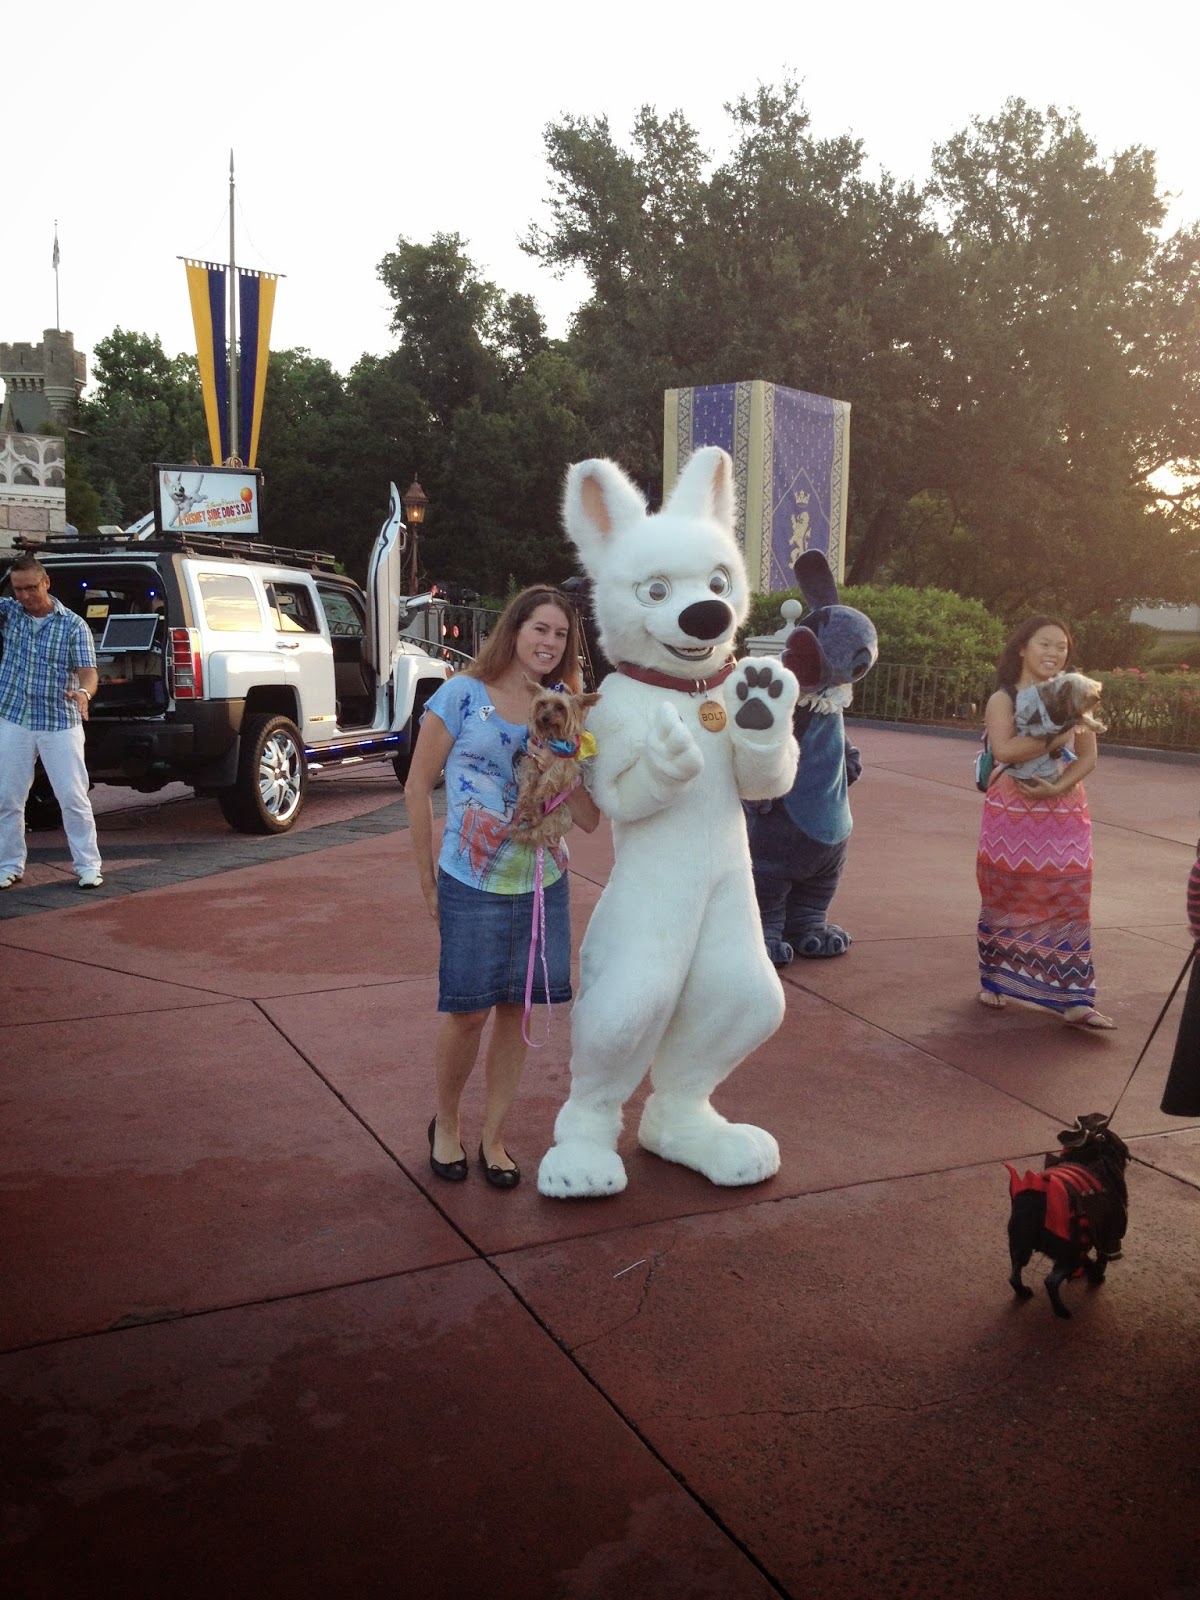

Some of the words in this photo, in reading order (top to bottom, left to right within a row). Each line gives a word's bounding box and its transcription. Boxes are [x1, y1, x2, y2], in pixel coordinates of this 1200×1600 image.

[206, 507, 222, 521] SIDE
[221, 504, 241, 518] DOG'S
[241, 502, 253, 515] DAY
[701, 711, 724, 722] BOLT
